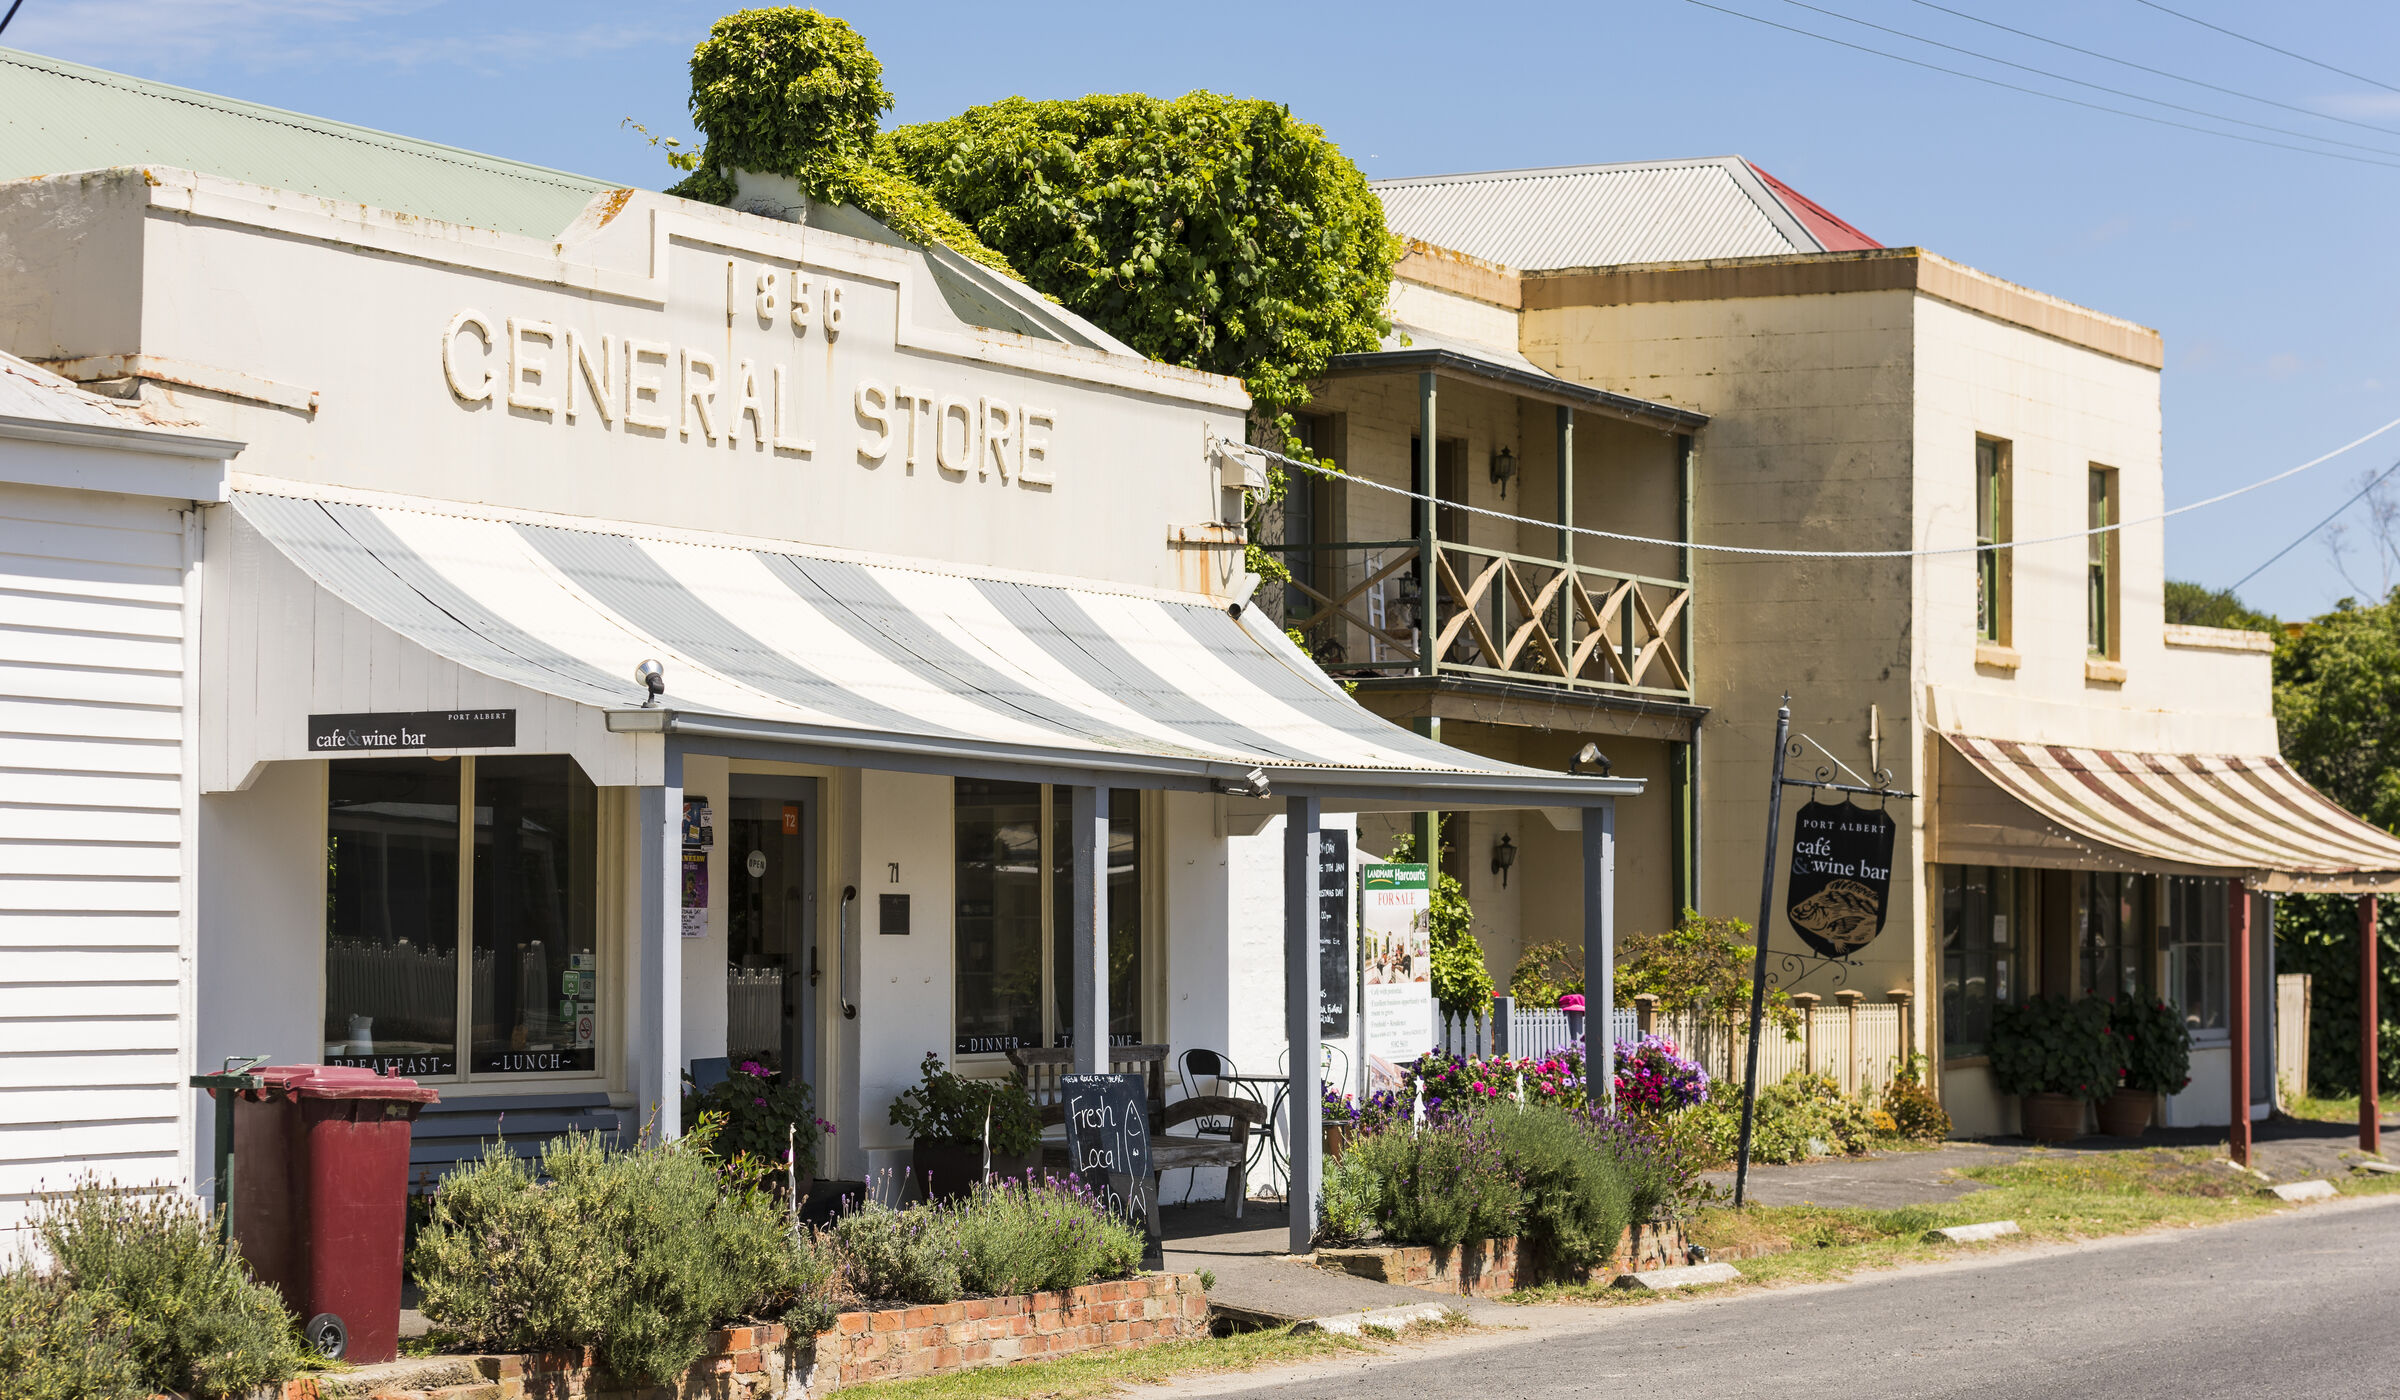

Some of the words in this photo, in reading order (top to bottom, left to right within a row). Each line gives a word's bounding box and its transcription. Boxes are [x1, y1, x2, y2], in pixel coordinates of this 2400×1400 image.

[727, 257, 843, 333] 1856
[442, 308, 816, 454] GENERAL
[853, 378, 1057, 487] STORE
[474, 712, 506, 720] ALBERT
[402, 728, 426, 746] bar
[785, 814, 796, 828] T2
[1804, 819, 1834, 830] PORT
[1840, 823, 1886, 834] ALBERT
[1796, 837, 1831, 856] café
[749, 858, 765, 870] OPEN
[888, 862, 899, 883] 71
[1812, 857, 1855, 876] wine
[1860, 859, 1889, 881] bar
[1368, 869, 1394, 878] LANDMARK
[1395, 868, 1426, 881] Harcourts
[1378, 892, 1394, 905] FOR
[1396, 892, 1416, 905] SALE
[1071, 1095, 1116, 1135] Fresh
[1077, 1132, 1122, 1172] Local
